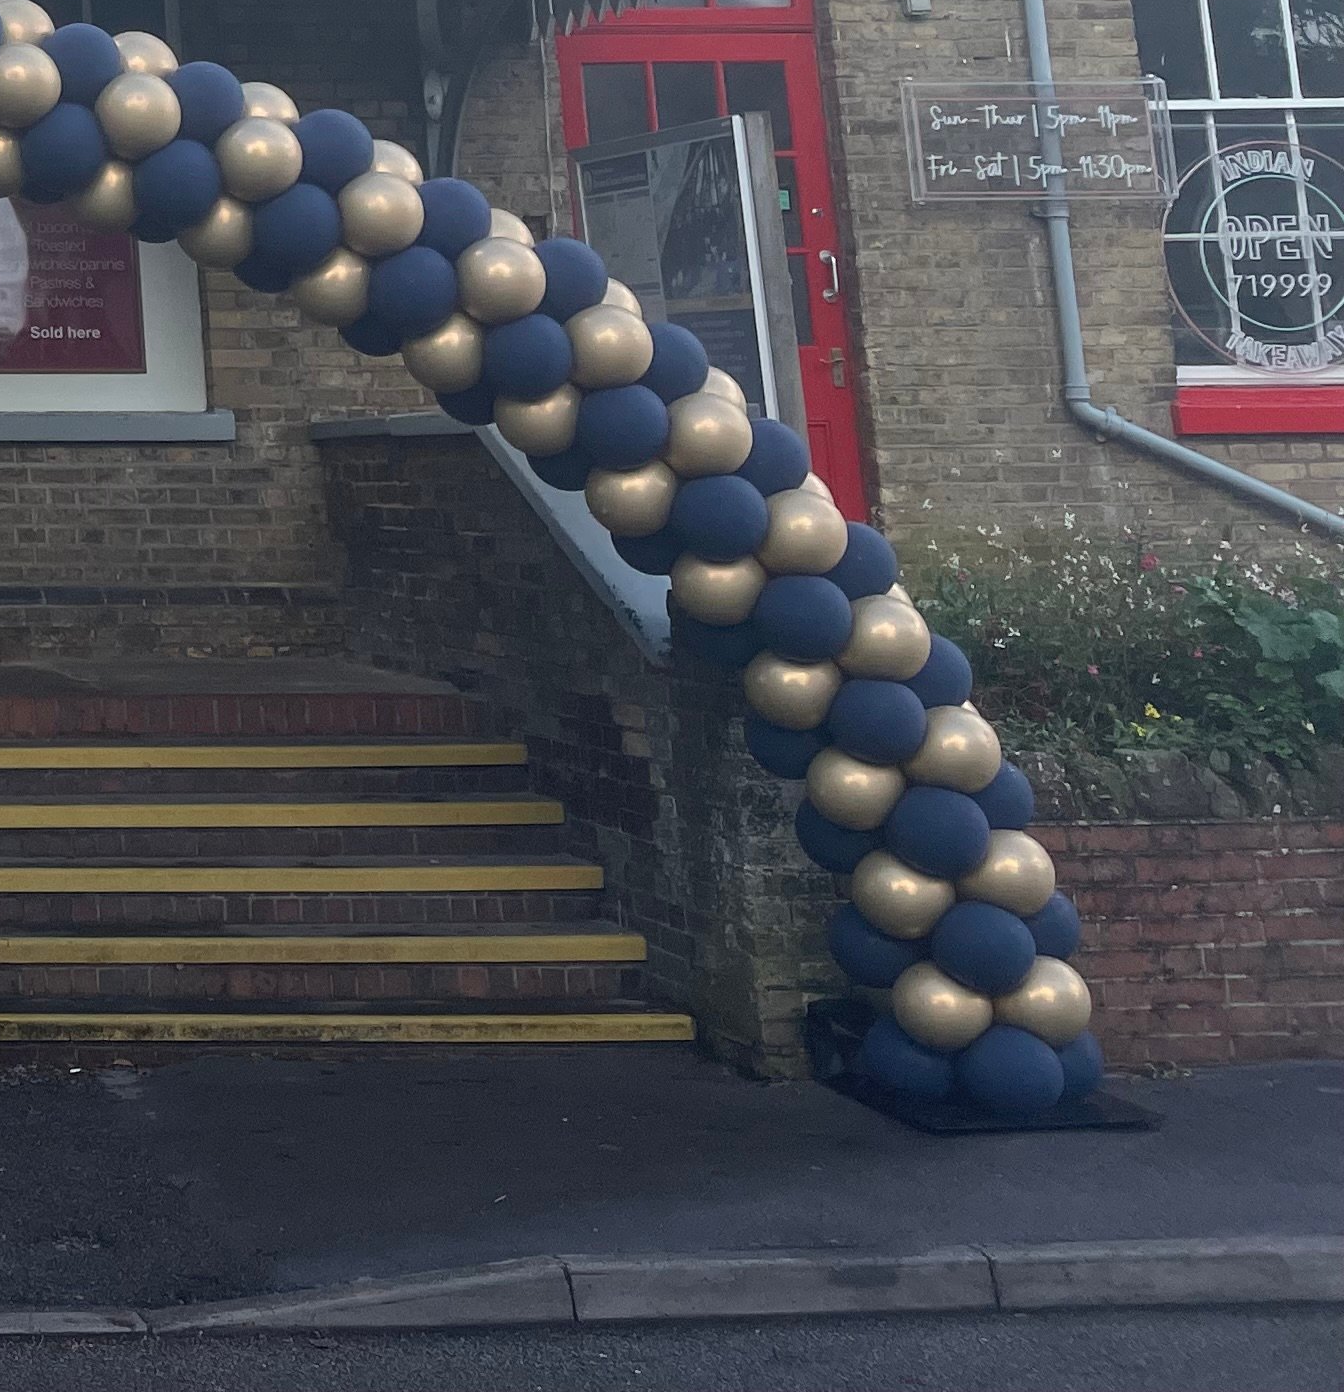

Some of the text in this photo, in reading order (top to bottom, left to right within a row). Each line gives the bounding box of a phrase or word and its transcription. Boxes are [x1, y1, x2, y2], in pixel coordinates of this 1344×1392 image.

[1217, 150, 1315, 183] INDIAN
[1219, 214, 1333, 261] OPEN
[1228, 273, 1333, 298] 719999
[24, 294, 103, 308] Sandwiches
[30, 326, 101, 339] Sold here
